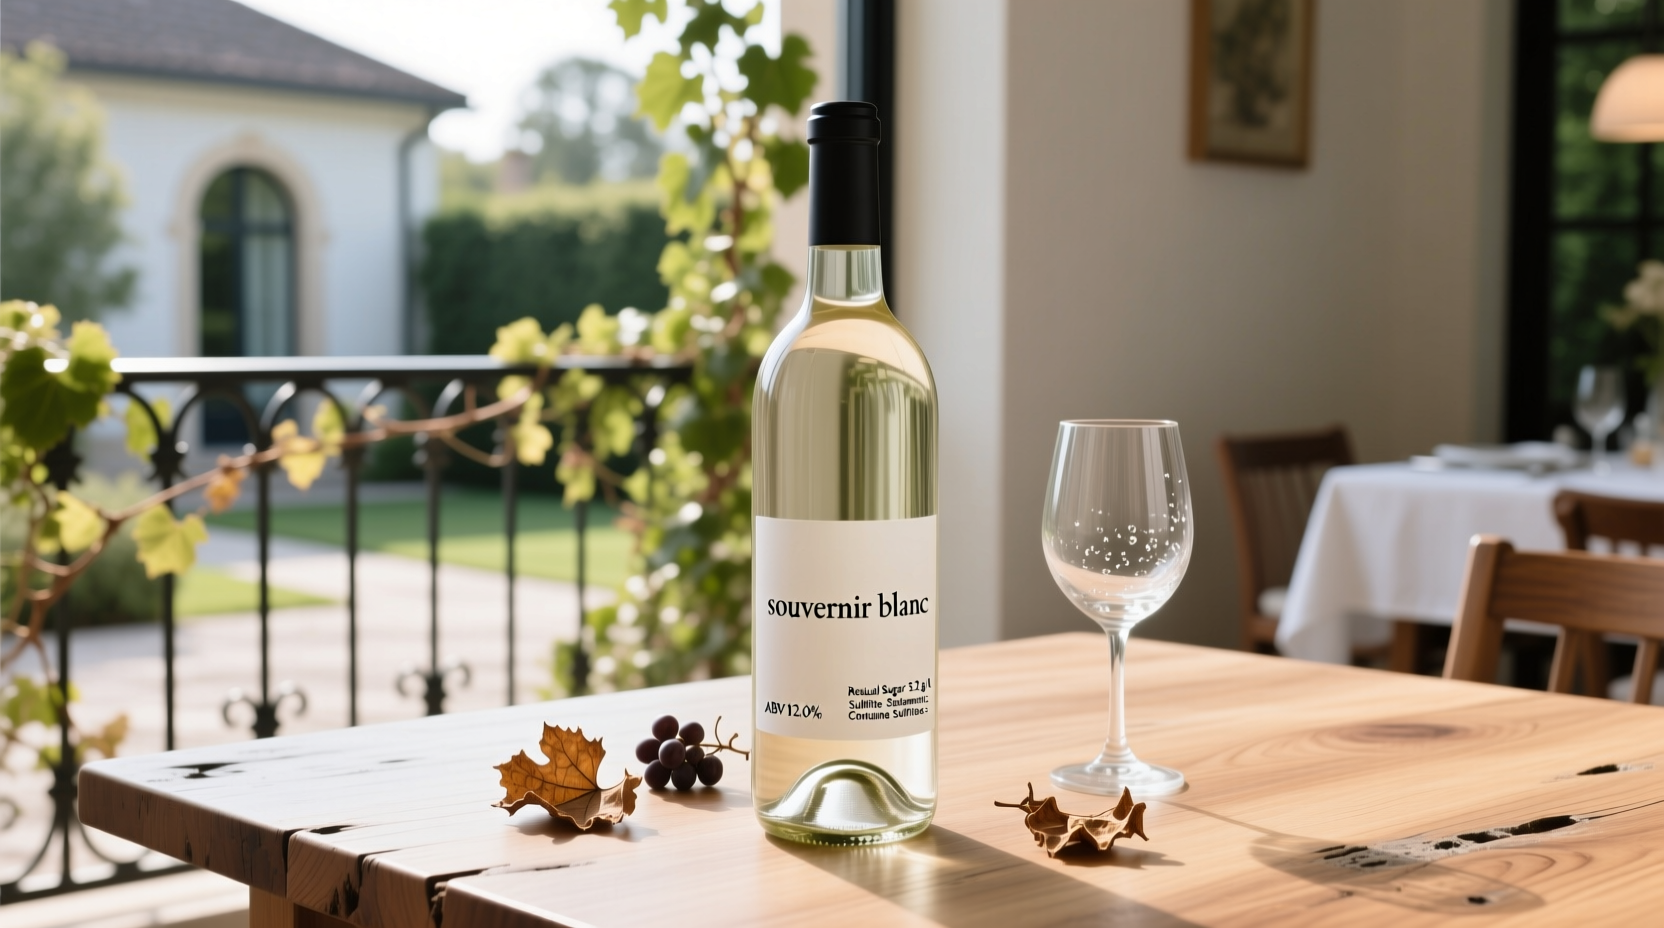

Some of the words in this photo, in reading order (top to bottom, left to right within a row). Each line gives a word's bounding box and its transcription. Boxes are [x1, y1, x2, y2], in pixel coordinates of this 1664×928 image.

[767, 595, 872, 619] souvernir
[877, 591, 929, 618] blanc
[764, 701, 786, 715] ABV
[787, 703, 823, 720] 12.0%
